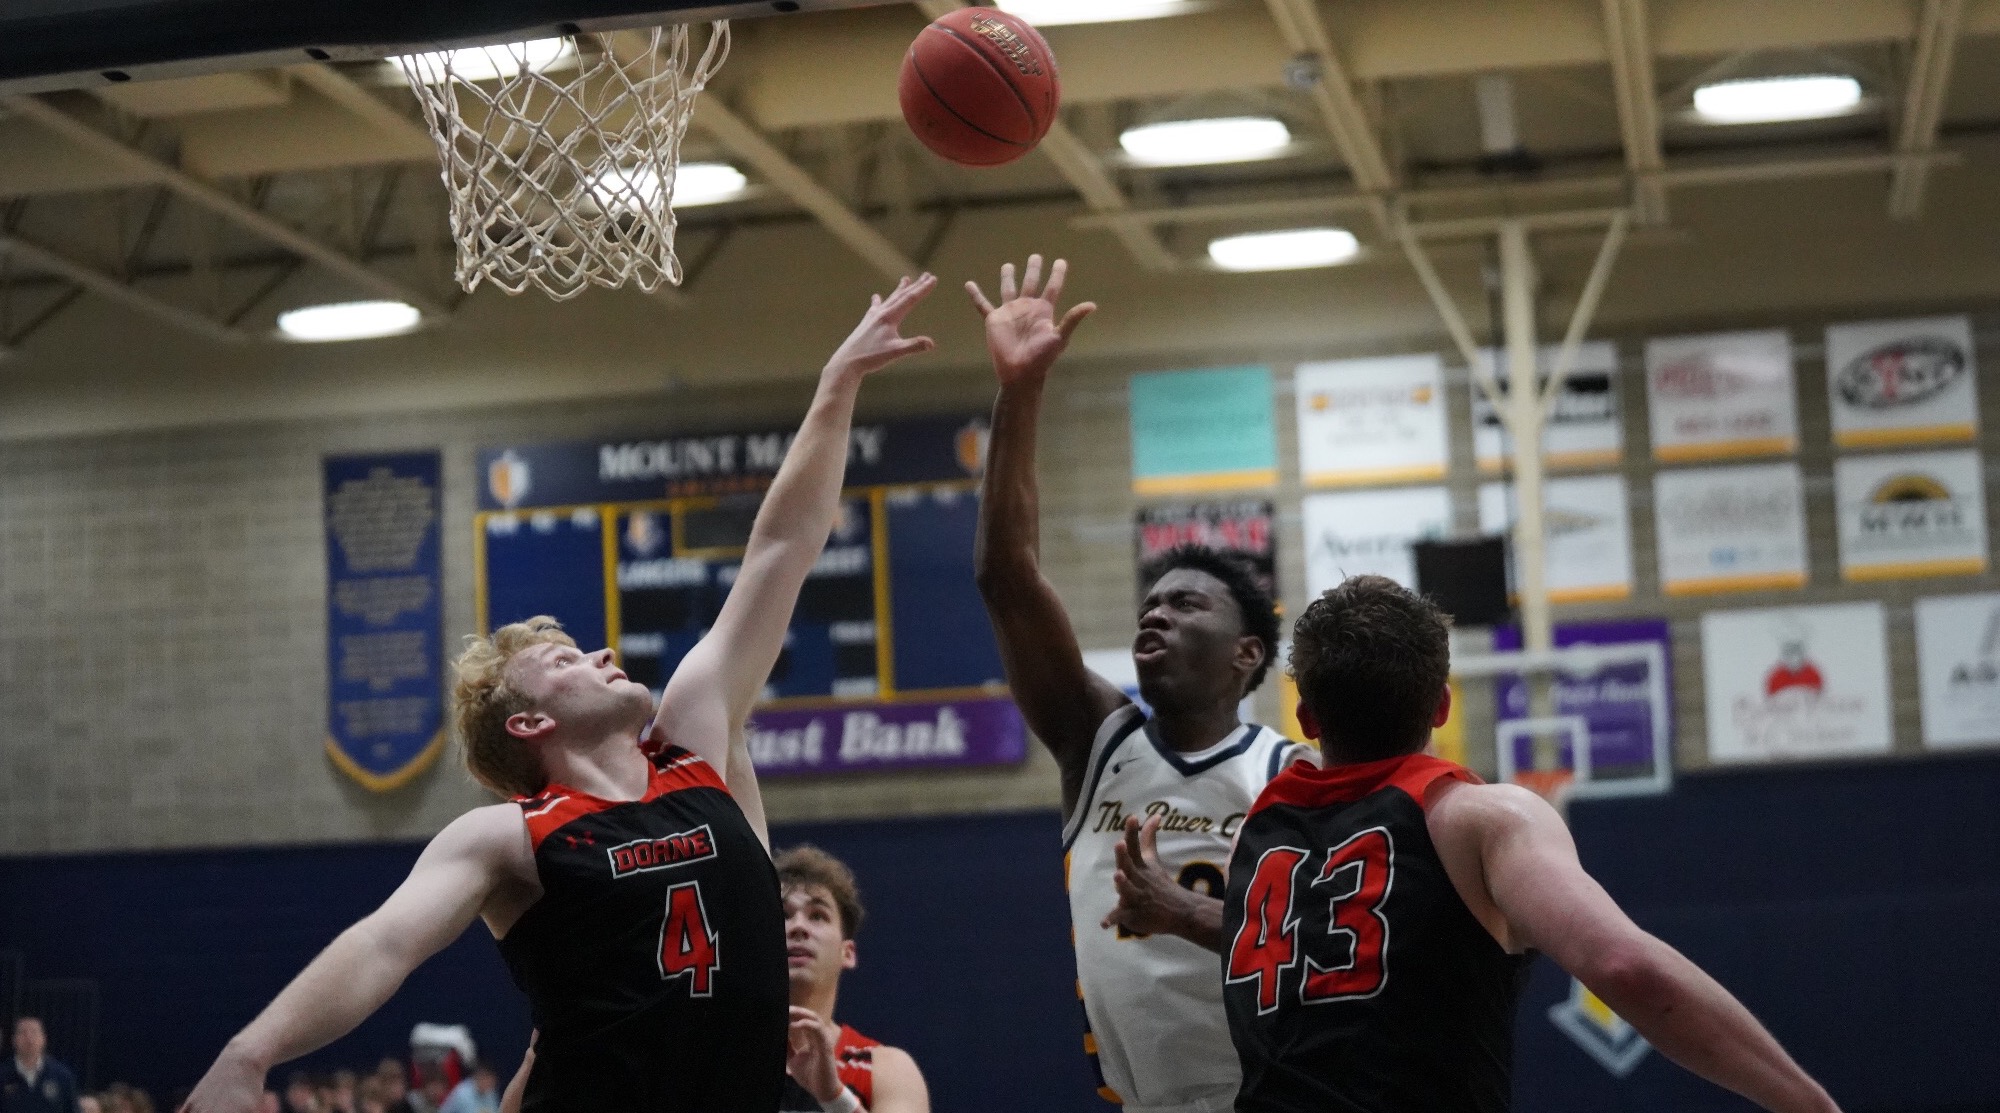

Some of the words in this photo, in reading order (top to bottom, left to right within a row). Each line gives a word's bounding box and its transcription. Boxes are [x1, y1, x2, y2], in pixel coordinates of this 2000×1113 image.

[599, 435, 737, 479] MOUNT
[750, 717, 826, 765] ust
[840, 706, 967, 763] Bank
[1145, 800, 1215, 833] River
[657, 880, 720, 997] 4
[1225, 826, 1394, 1016] 43
